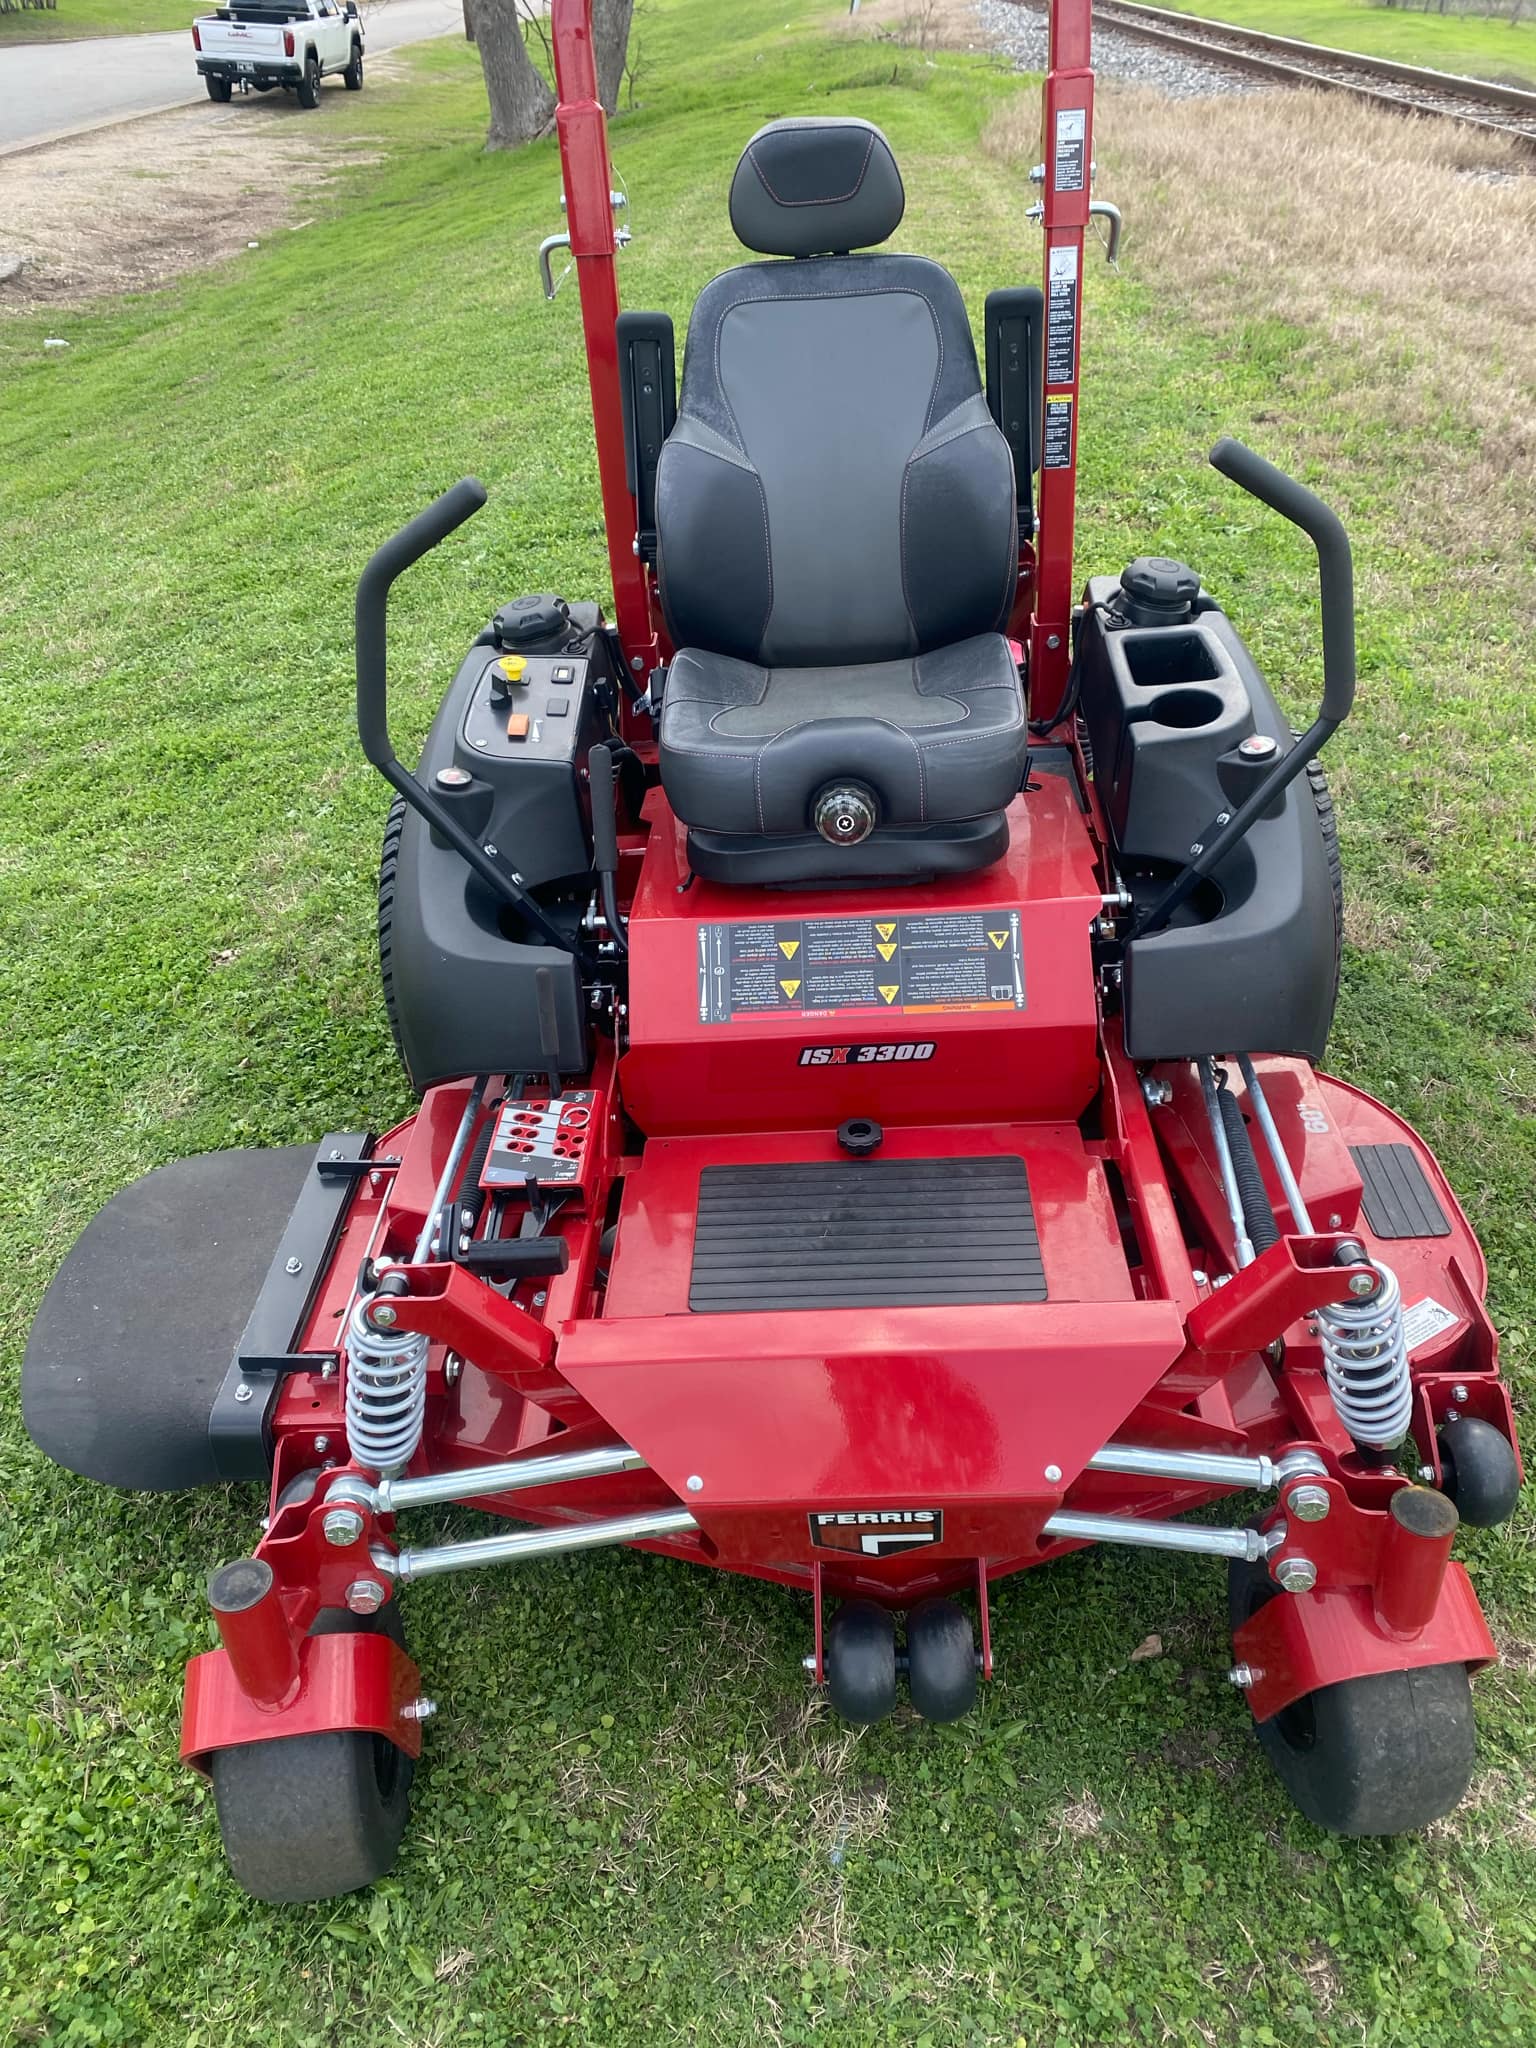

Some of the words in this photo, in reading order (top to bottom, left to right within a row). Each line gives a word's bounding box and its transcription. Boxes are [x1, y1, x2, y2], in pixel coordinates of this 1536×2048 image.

[800, 1047, 850, 1065] ISX
[857, 1043, 934, 1062] 3300
[817, 1511, 934, 1525] FERRIS
